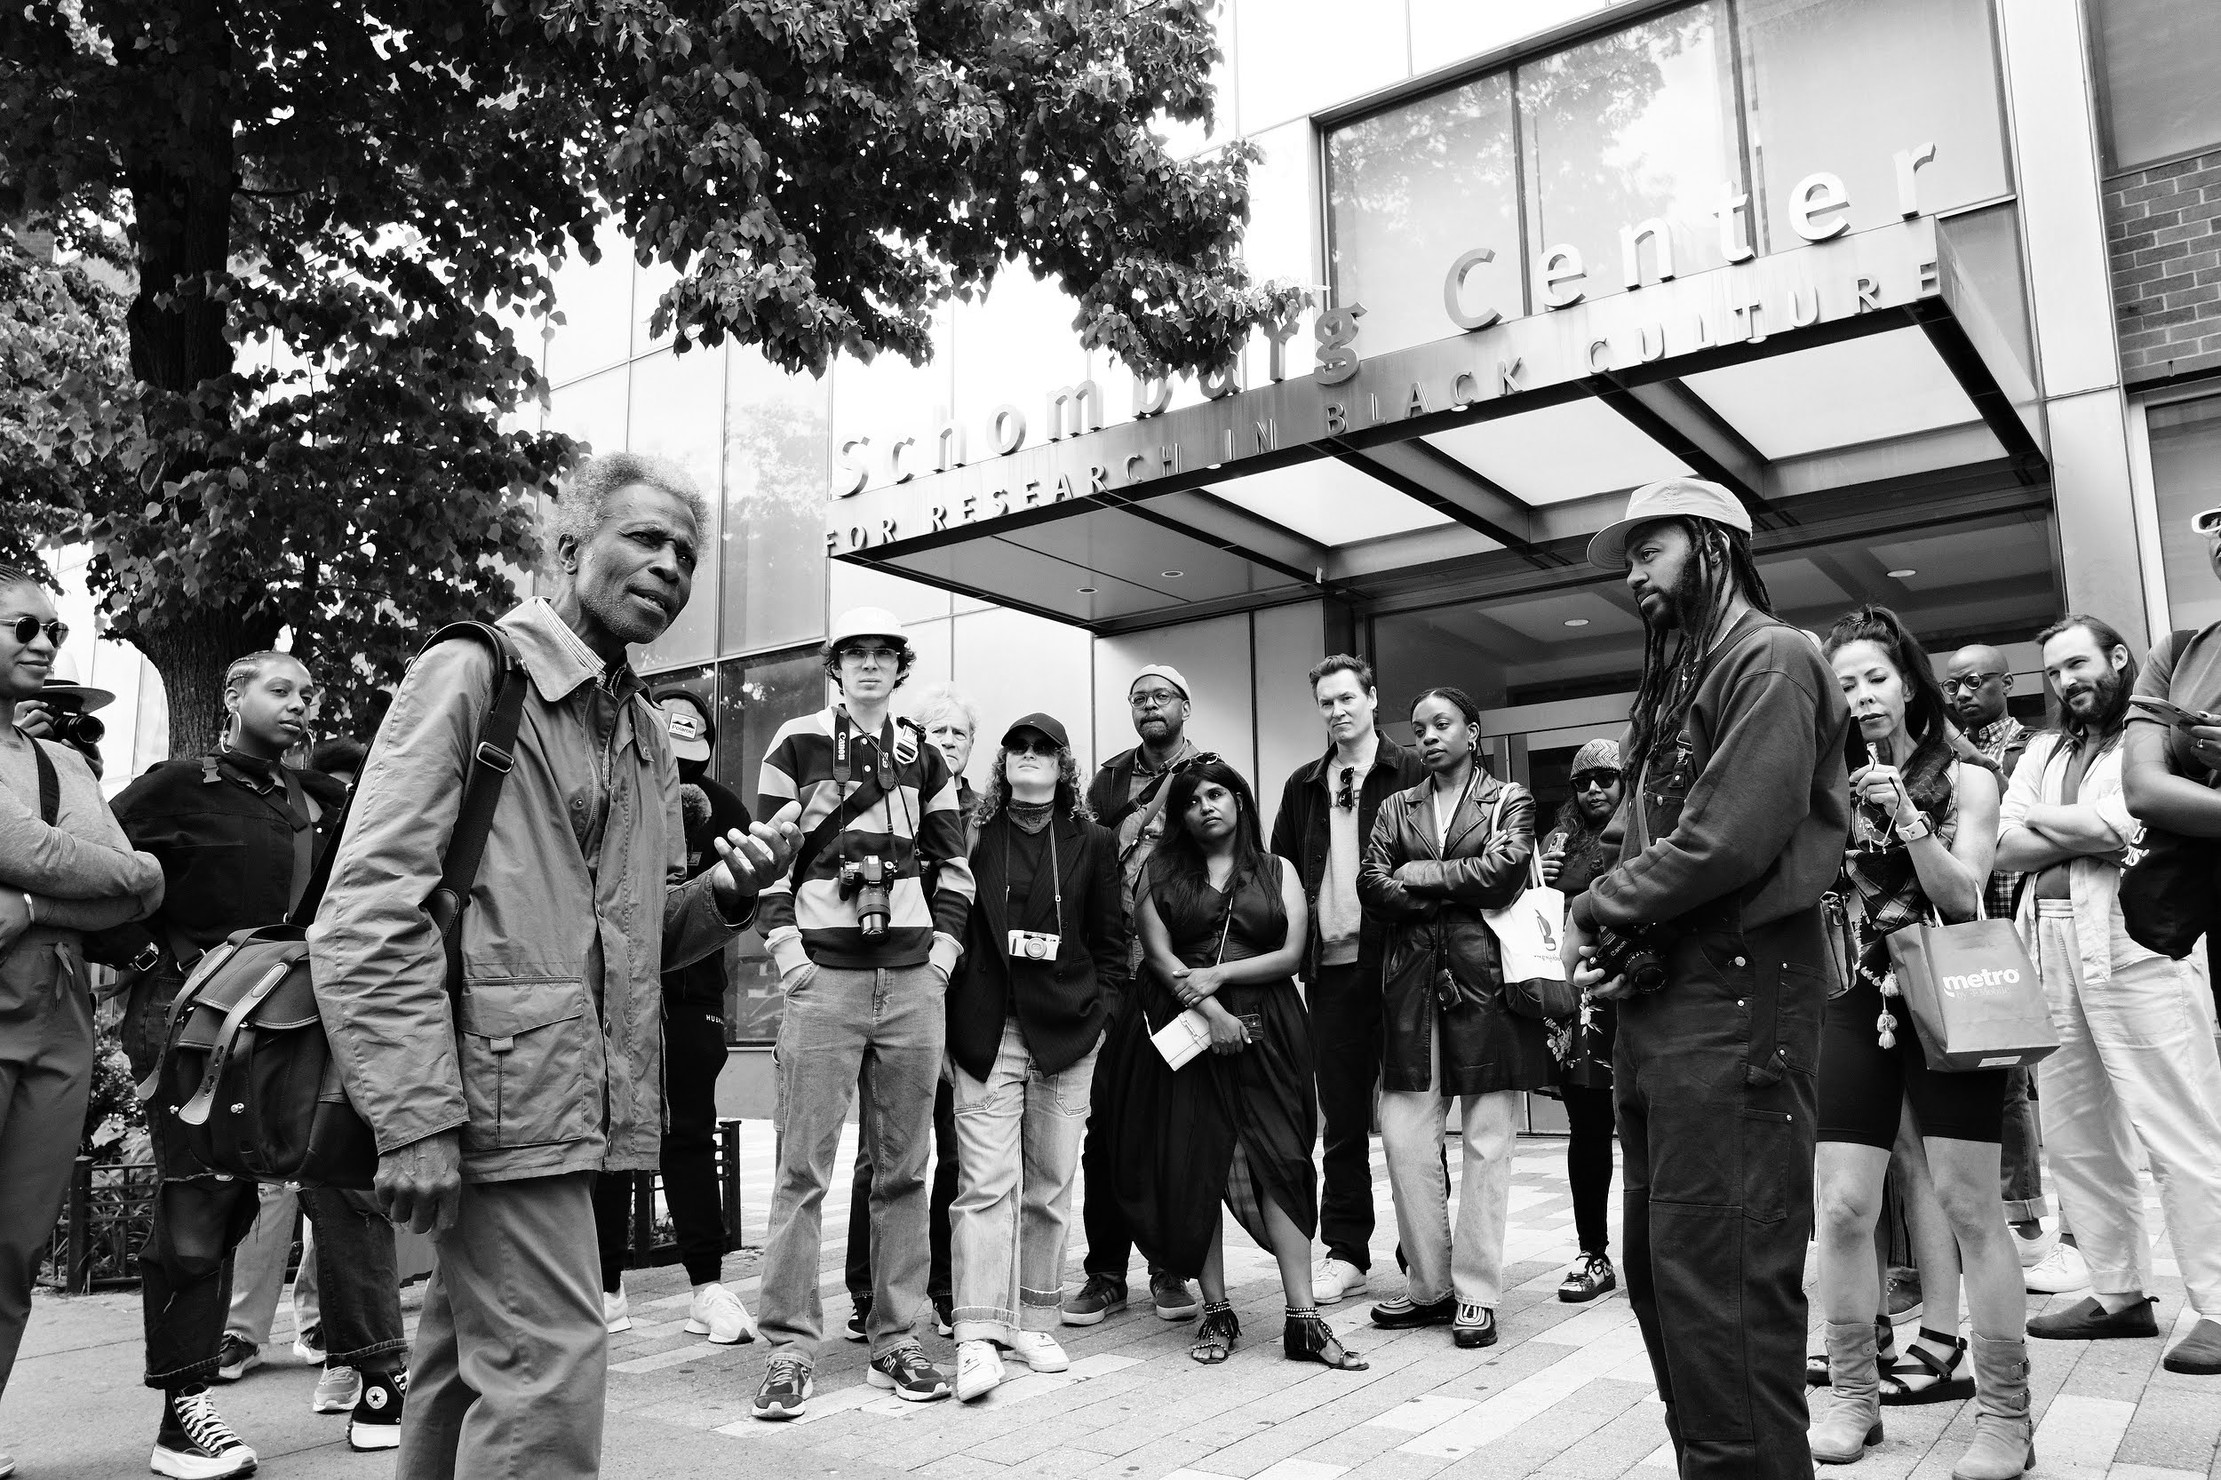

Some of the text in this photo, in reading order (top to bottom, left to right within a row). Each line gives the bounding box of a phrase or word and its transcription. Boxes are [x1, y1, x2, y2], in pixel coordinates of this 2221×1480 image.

[1443, 142, 1937, 332] Center
[826, 260, 1938, 557] FOR RESEARCH IN BLACK CULTURE
[672, 724, 694, 735] Polaroid
[838, 731, 847, 760] Canon
[1610, 940, 1627, 956] Canon
[1942, 968, 2020, 990] metro
